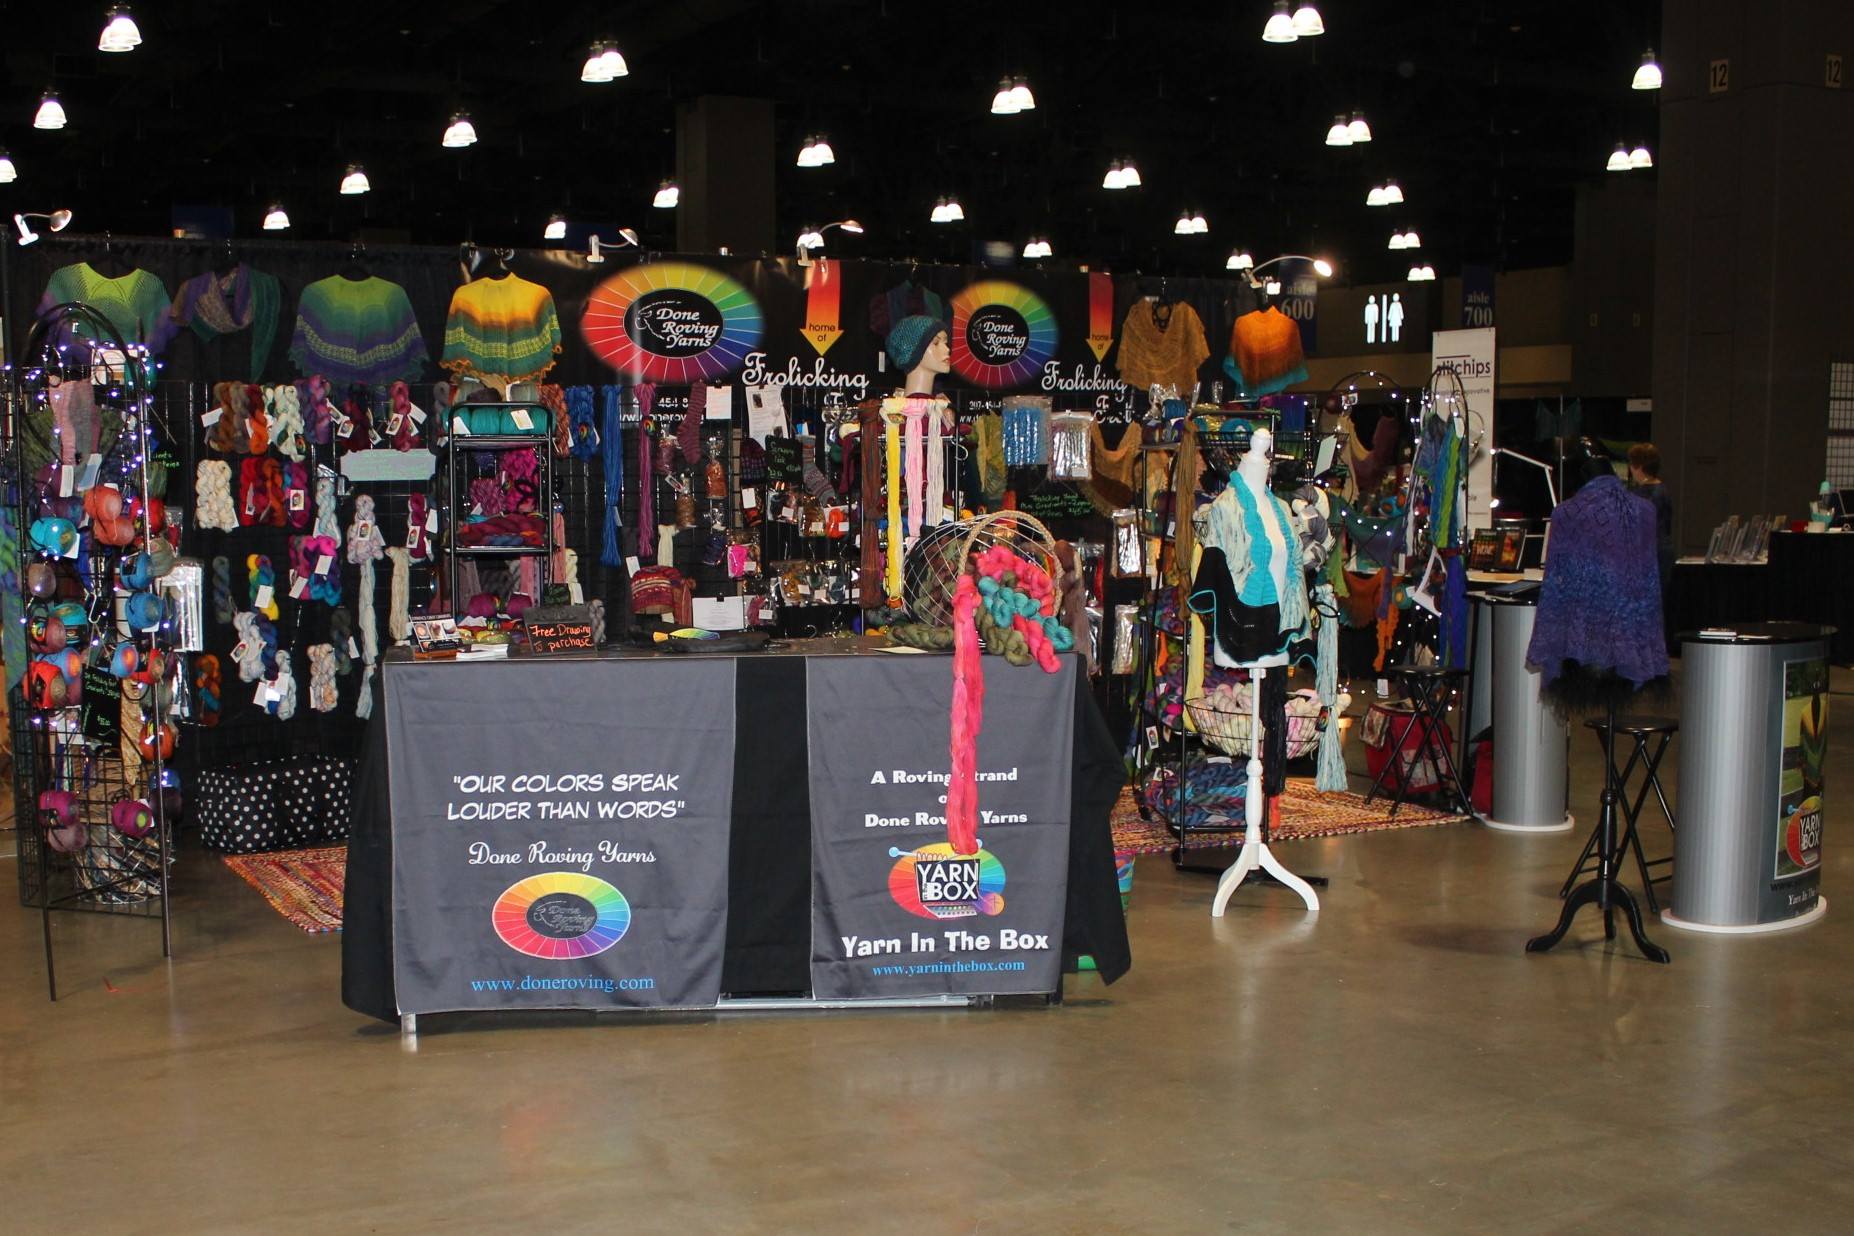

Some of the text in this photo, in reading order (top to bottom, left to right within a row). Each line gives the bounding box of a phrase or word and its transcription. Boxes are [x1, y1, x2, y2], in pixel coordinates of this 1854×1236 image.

[1711, 64, 1728, 87] 12
[1826, 60, 1842, 83] 12
[656, 308, 700, 321] Done
[1281, 298, 1314, 320] 600
[1464, 306, 1493, 328] 700
[661, 322, 720, 338] Roving
[809, 323, 836, 332] home
[983, 321, 1014, 333] Done
[665, 334, 712, 348] Yarns
[816, 333, 828, 342] of
[986, 334, 1027, 349] Roving
[988, 345, 1021, 357] Yarns
[742, 352, 870, 400] Frolicking
[1041, 360, 1128, 402] Frolicking
[530, 623, 592, 638] Free Drawing
[453, 773, 680, 793] "OUR COLORS SPEAK
[870, 768, 1018, 787] A Roving trand
[448, 800, 686, 821] LOUDER THAN WORDS"
[865, 811, 1028, 828] Done Rov Yarns
[1800, 814, 1820, 835] YARN
[1801, 831, 1820, 850] BOX
[468, 840, 656, 872] Done Roving Yarns
[917, 862, 979, 882] YARN
[926, 881, 978, 900] BOX
[842, 929, 1049, 958] Yarn In The Box
[872, 959, 1025, 977] www.yarninthebox.com
[470, 974, 655, 993] www.doneroving.com
